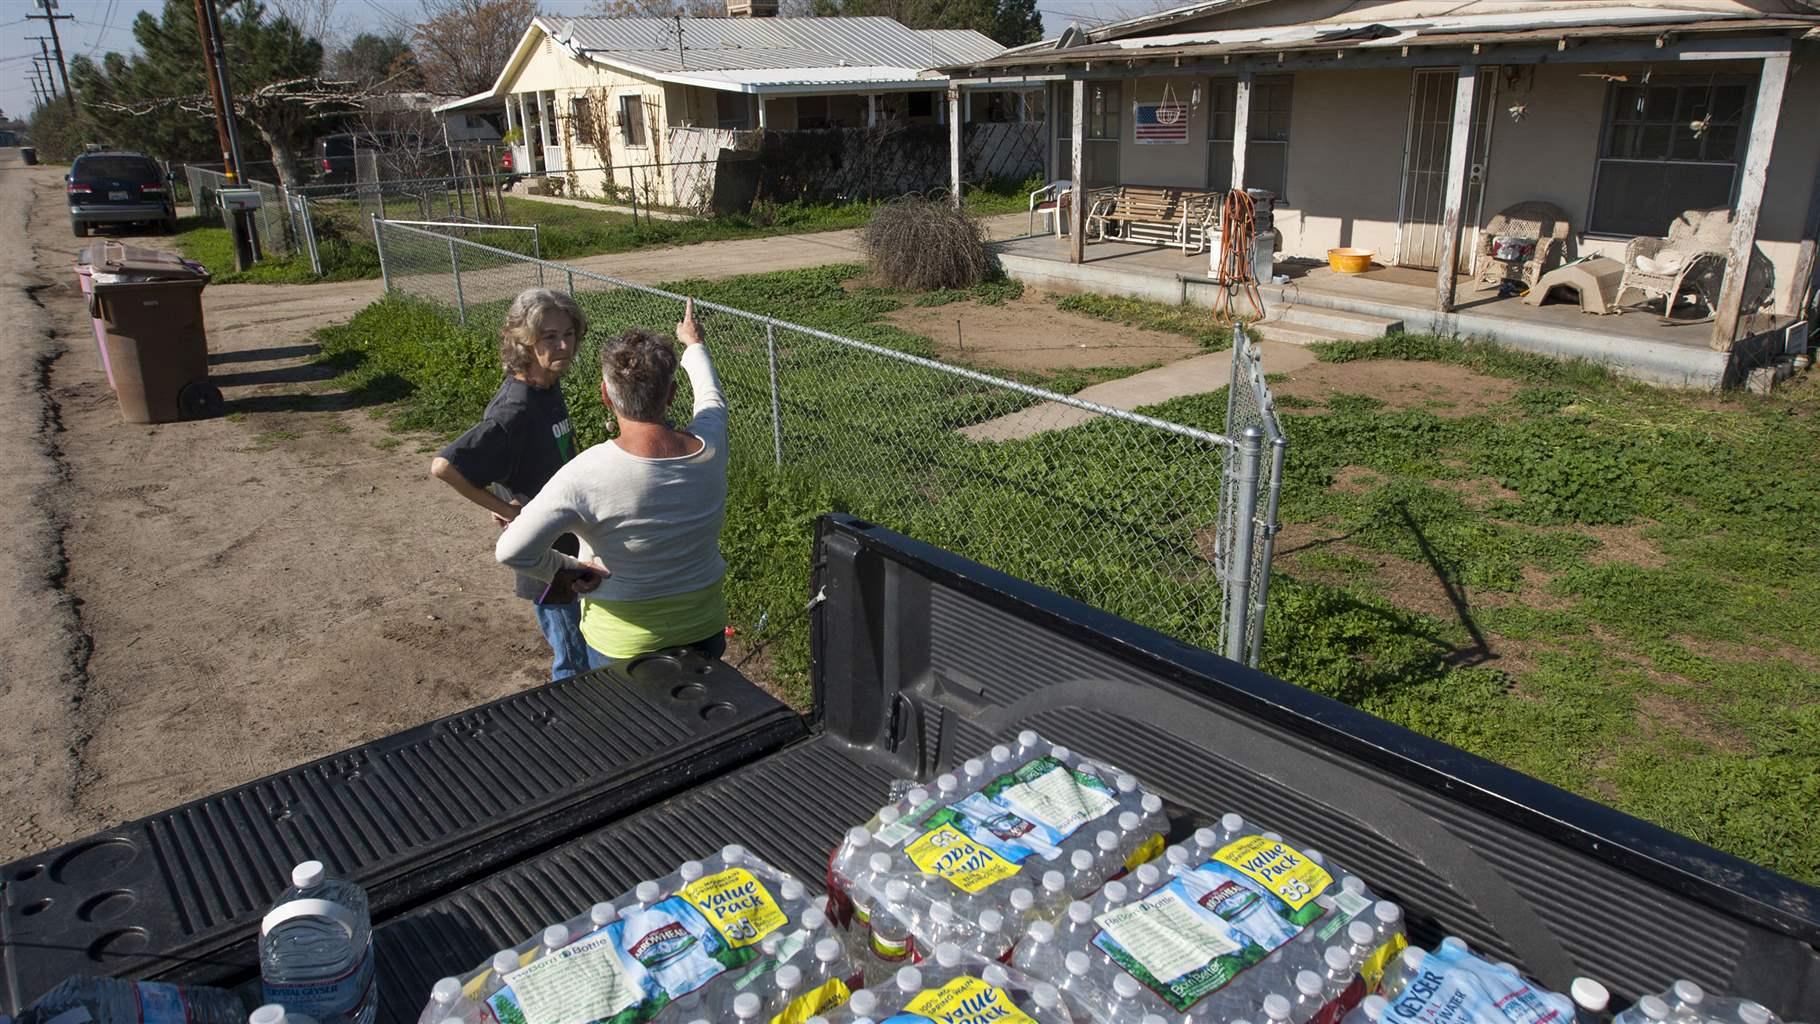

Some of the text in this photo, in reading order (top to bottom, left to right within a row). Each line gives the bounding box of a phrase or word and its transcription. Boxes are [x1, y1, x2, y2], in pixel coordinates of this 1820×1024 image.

[932, 843, 975, 873] Pack
[1240, 844, 1287, 873] Value
[1260, 855, 1301, 882] Pack
[699, 881, 757, 909] Value
[1279, 878, 1311, 901] 35
[714, 895, 764, 919] Pack
[724, 917, 757, 940] 35
[571, 937, 608, 954] Bottle
[939, 987, 998, 1024] Value
[1394, 971, 1444, 1018] GEYSER
[1440, 988, 1467, 1020] WATER
